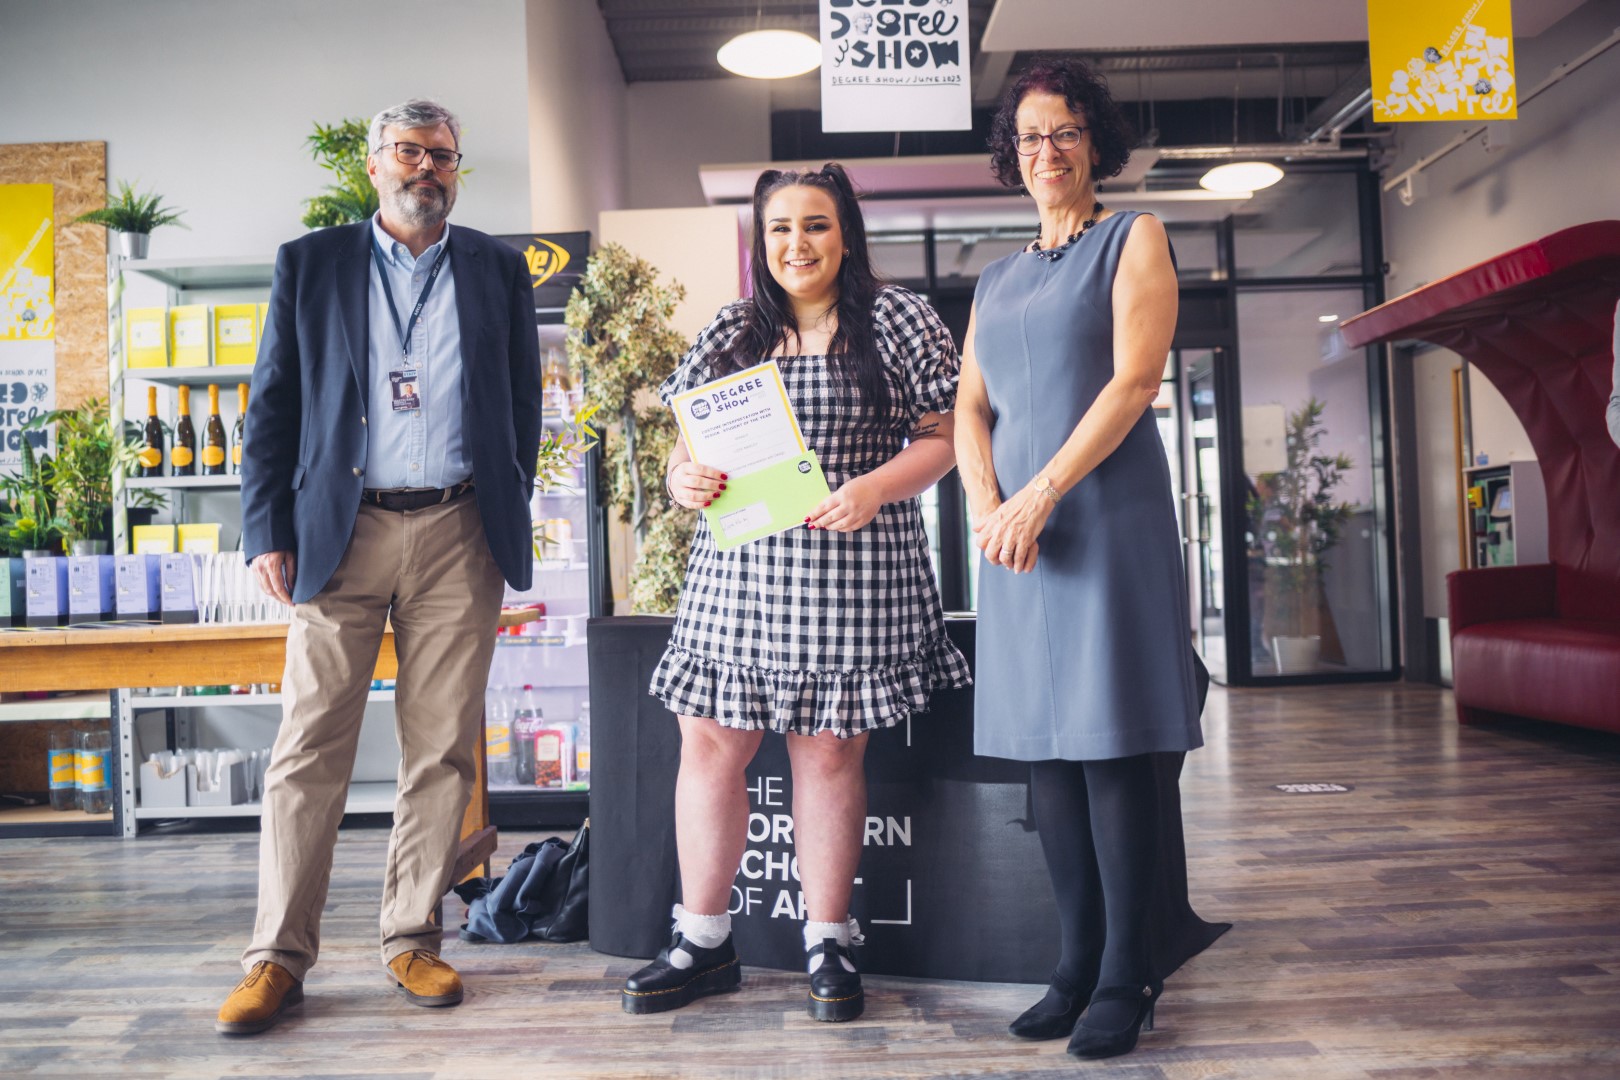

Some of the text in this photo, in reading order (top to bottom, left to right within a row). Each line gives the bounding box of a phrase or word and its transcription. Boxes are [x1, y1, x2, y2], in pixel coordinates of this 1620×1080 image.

[851, 40, 959, 69] SHOW
[832, 76, 870, 84] DEGREE
[712, 378, 763, 405] DEGREE
[716, 396, 749, 412] SHOW
[722, 423, 743, 433] STUDENT
[746, 776, 783, 806] HE
[747, 813, 912, 847] ORRN
